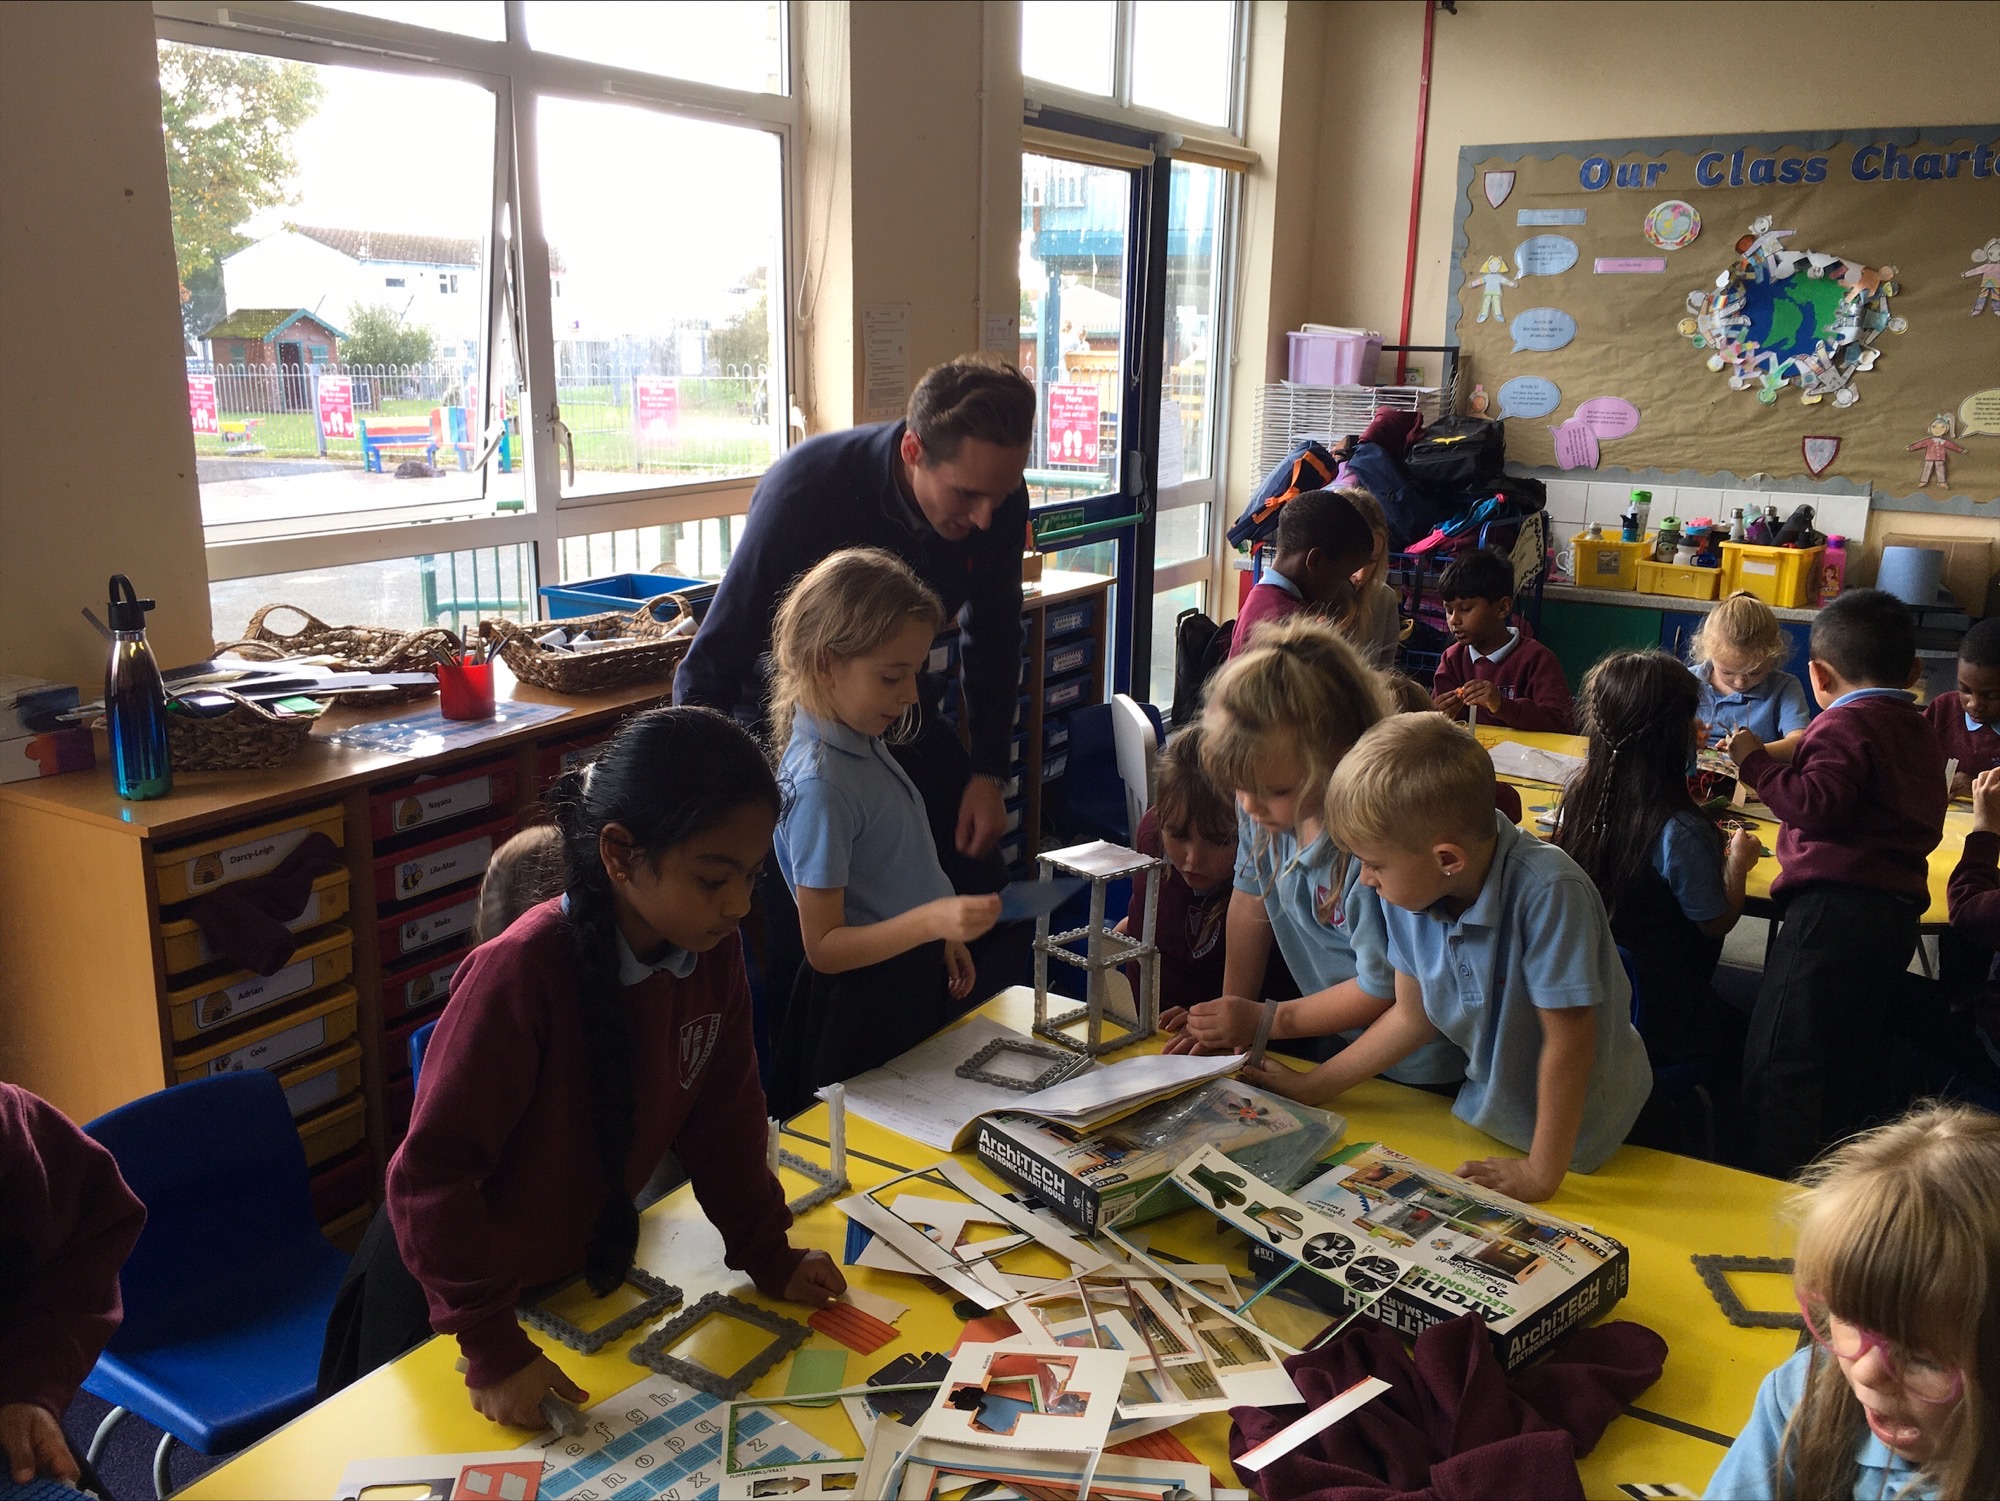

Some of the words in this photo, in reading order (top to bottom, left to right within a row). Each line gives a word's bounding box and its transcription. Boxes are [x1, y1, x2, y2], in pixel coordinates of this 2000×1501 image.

[1579, 156, 1669, 191] Our
[1694, 147, 1829, 188] Class
[1050, 386, 1075, 396] Please
[1075, 386, 1098, 396] Stand
[429, 797, 453, 810] Nayana
[229, 845, 275, 865] Darcy-Leigh
[430, 861, 457, 875] Lila-Mae
[434, 917, 452, 929] Blake
[439, 972, 452, 983] Row
[238, 985, 264, 1001] Adrian
[250, 1046, 267, 1058] Cole
[979, 1142, 1018, 1174] ELECTRONIC
[1017, 1167, 1042, 1190] SMART
[1041, 1181, 1066, 1205] HOUSE
[1411, 1264, 1431, 1280] SM
[1434, 1272, 1518, 1316] ELECTRONIC
[1486, 1285, 1510, 1299] 20
[1384, 1295, 1421, 1318] SMART
[1507, 1331, 1553, 1371] ELECTRONIC
[1552, 1317, 1577, 1340] SMART
[1577, 1293, 1600, 1319] HOUSE
[565, 1443, 585, 1457] e
[594, 1422, 615, 1444] f
[625, 1408, 649, 1426] g
[649, 1393, 677, 1408] h
[746, 1437, 769, 1453] z
[601, 1472, 627, 1489] n
[635, 1454, 655, 1469] o
[663, 1436, 686, 1455] p
[694, 1420, 722, 1435] q
[686, 1472, 711, 1489] x
